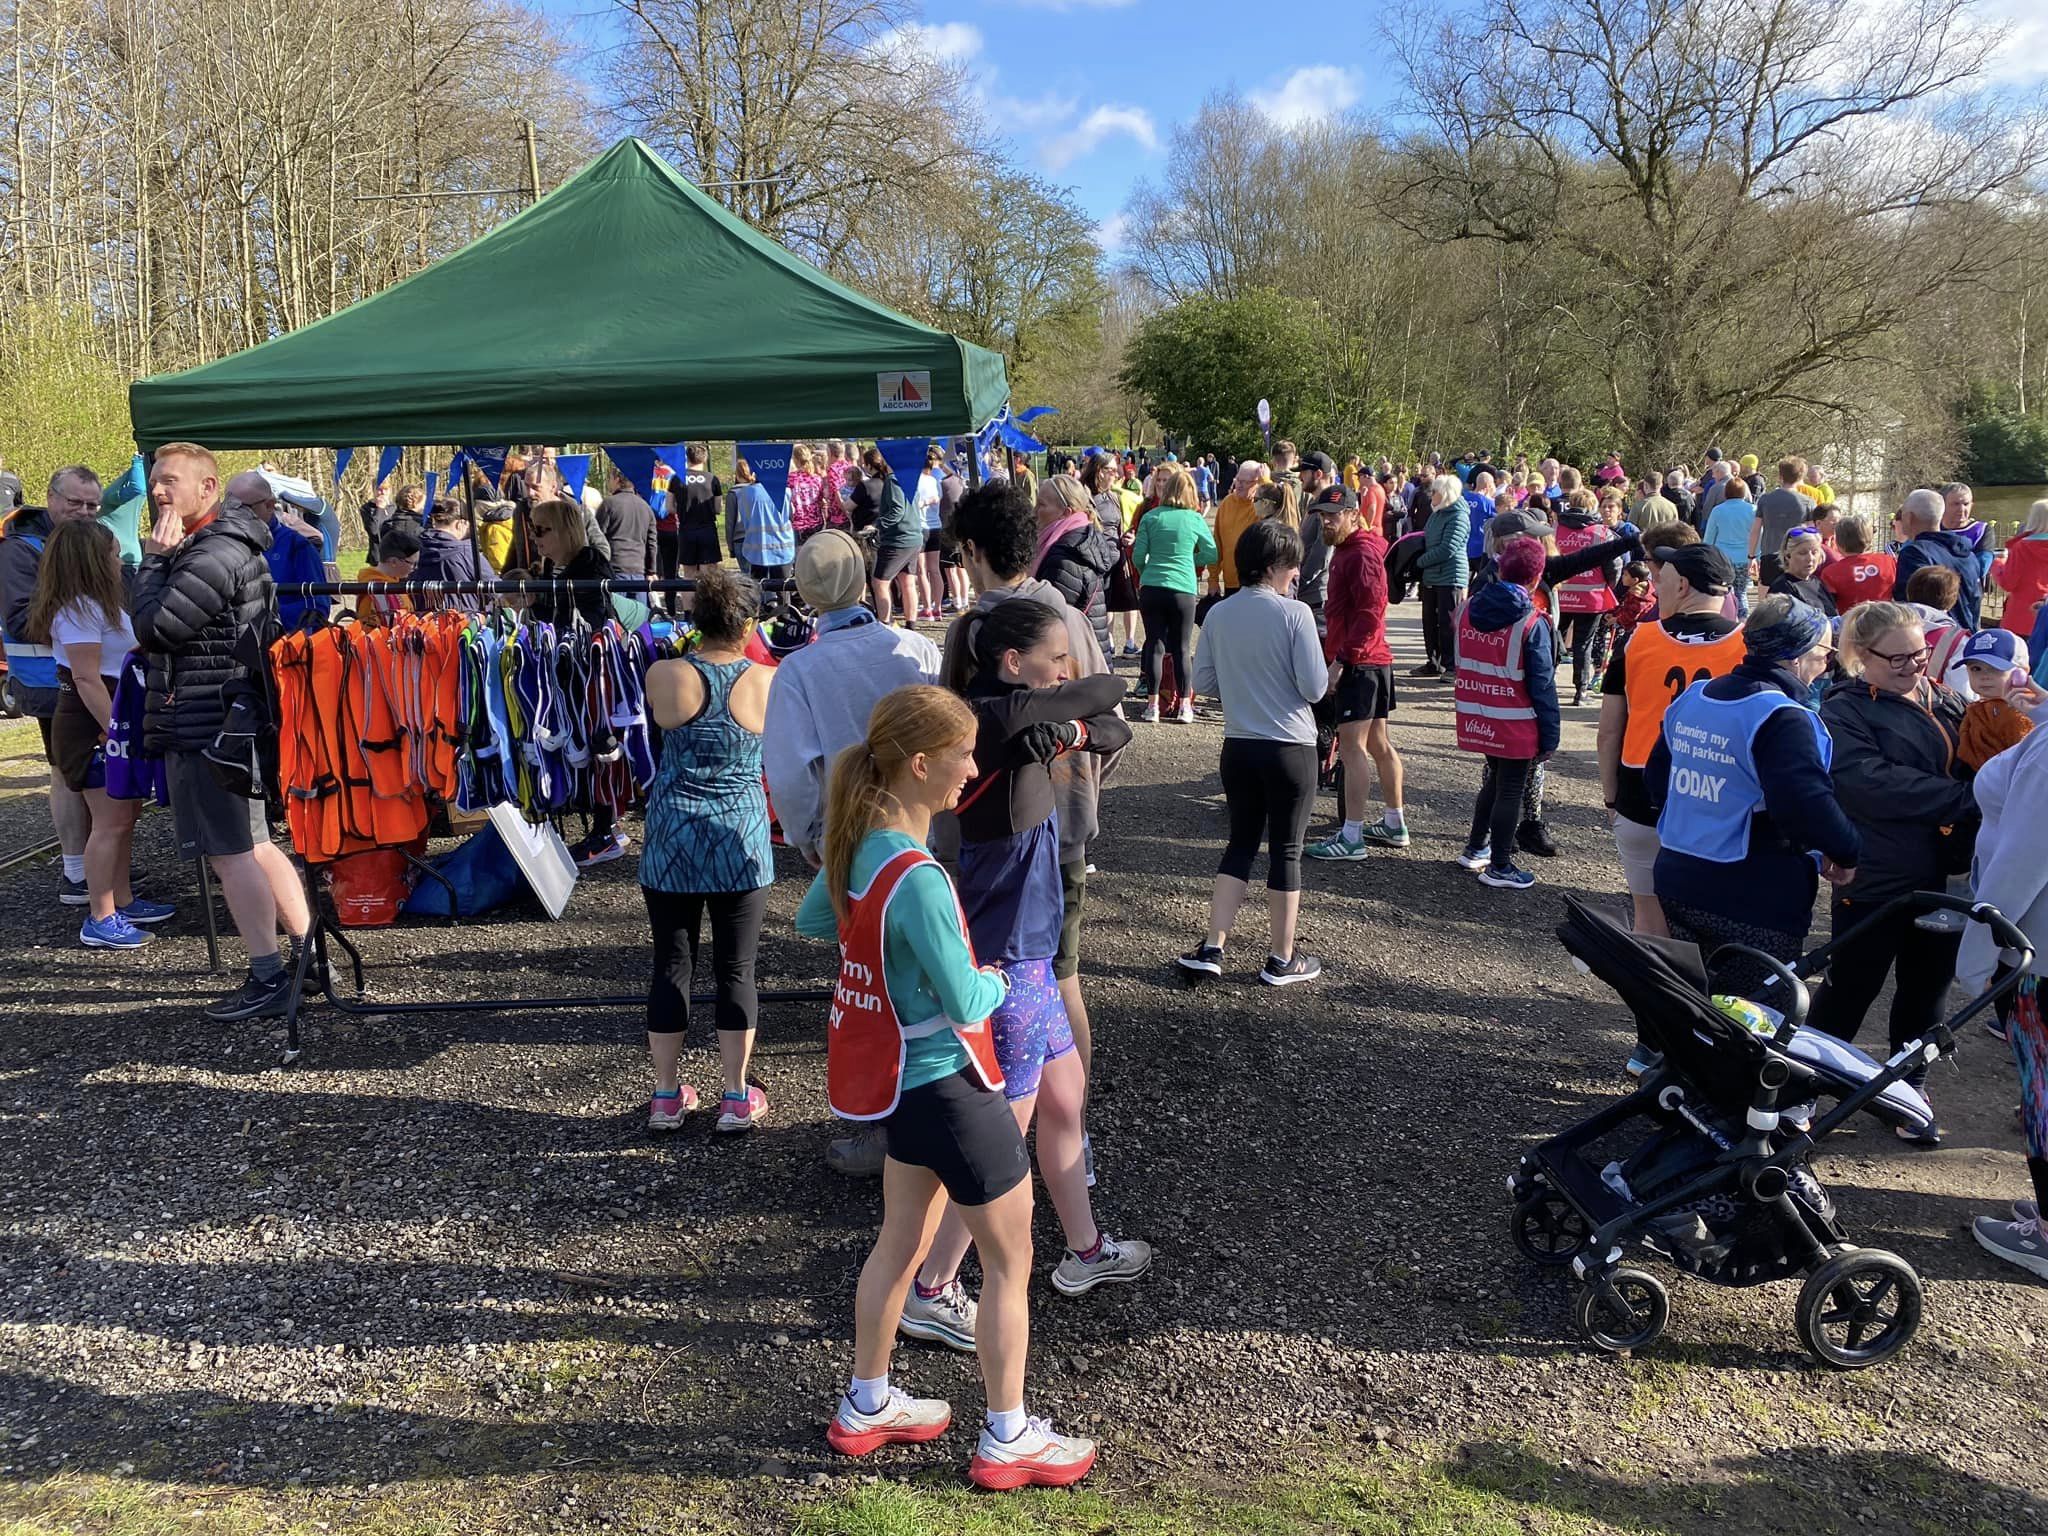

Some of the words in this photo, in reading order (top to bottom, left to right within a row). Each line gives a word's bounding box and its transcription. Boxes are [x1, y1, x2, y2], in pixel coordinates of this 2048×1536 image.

[882, 401, 929, 410] ABCCANOPY
[754, 458, 785, 470] V500
[1854, 564, 1879, 583] 50
[1461, 627, 1505, 648] parkrun
[1465, 718, 1496, 741] Vitality
[1675, 721, 1708, 744] Running
[1711, 733, 1730, 750] my
[1692, 746, 1736, 766] parkrun
[1670, 766, 1726, 803] TODAY
[843, 959, 873, 987] my
[835, 978, 883, 1013] krun
